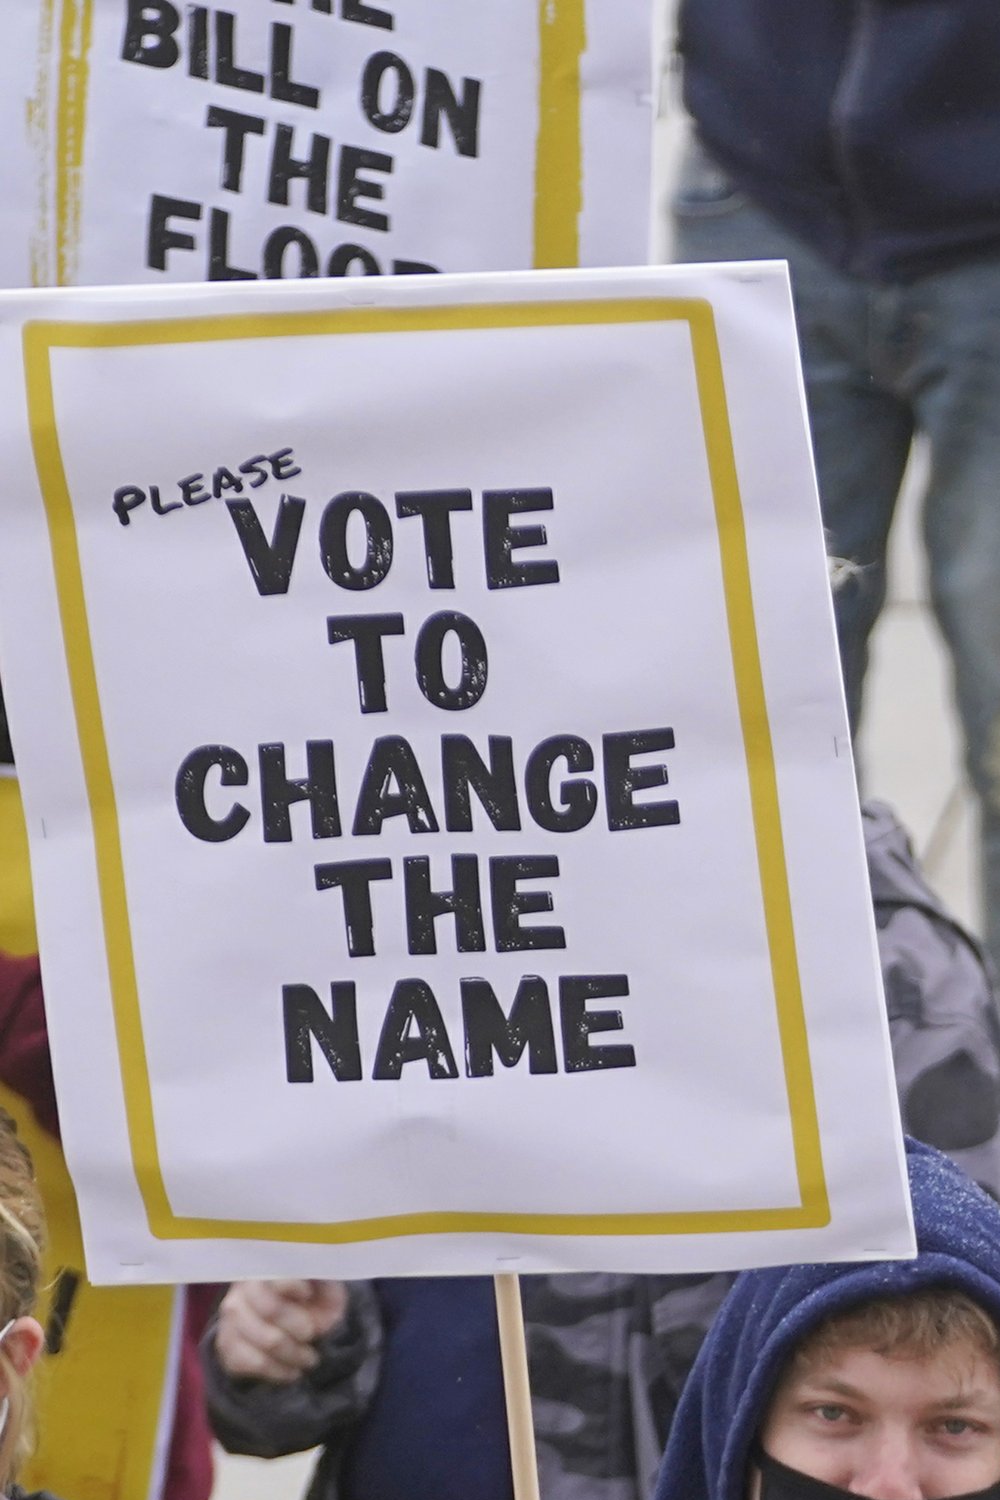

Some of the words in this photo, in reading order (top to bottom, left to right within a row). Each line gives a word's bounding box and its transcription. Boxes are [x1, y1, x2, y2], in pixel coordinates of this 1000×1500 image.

[121, 0, 320, 110] BILL
[361, 50, 483, 160] ON
[205, 104, 395, 234] THE
[112, 447, 302, 526] PLEASE
[225, 486, 561, 596] VOTE
[325, 609, 489, 714] TO
[174, 726, 681, 843] CHANGE
[313, 852, 567, 958] THE
[281, 973, 637, 1084] NAME
